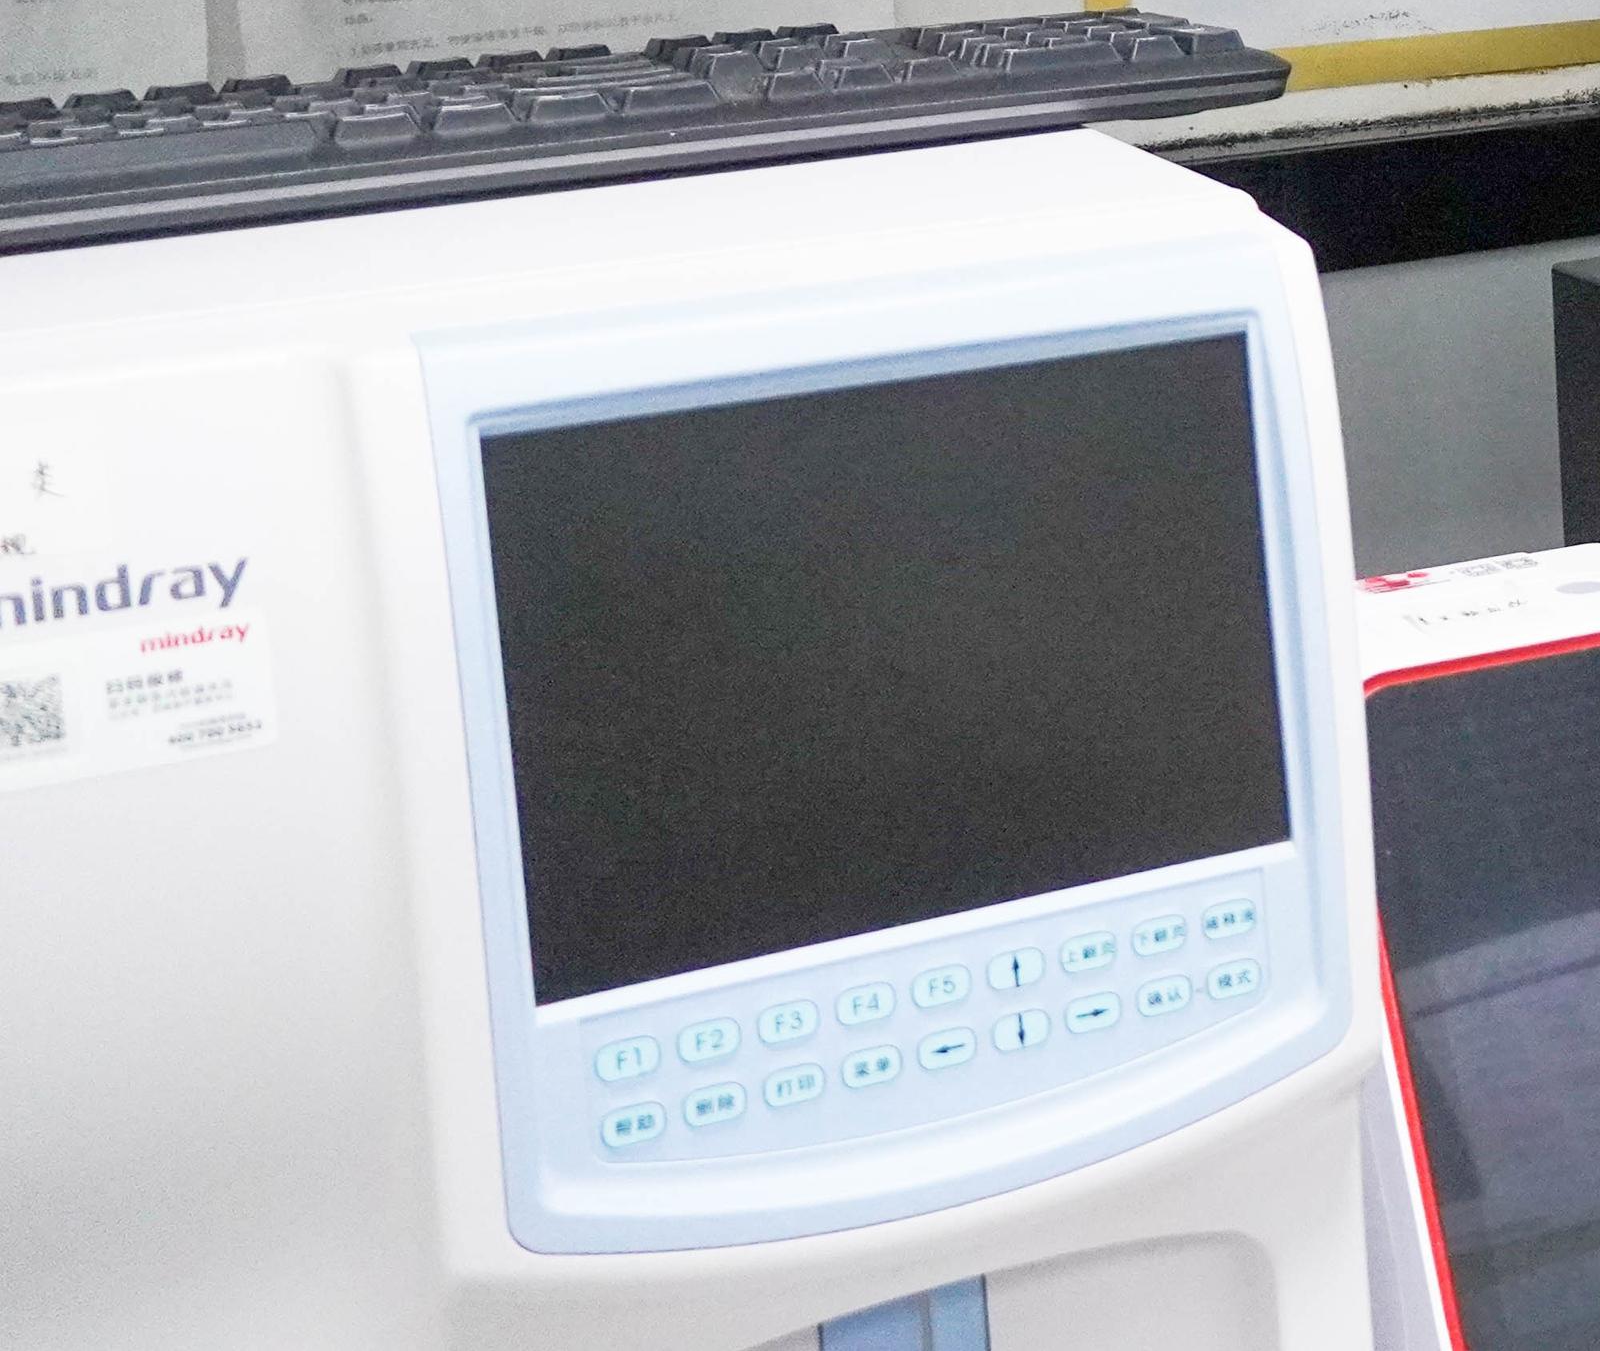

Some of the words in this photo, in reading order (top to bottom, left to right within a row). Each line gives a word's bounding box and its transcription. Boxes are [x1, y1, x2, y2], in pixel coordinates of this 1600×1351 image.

[140, 622, 249, 654] mindray
[928, 974, 957, 998] F5
[853, 992, 880, 1016] F4
[774, 1010, 802, 1034] F3
[695, 1029, 725, 1052] F2
[616, 1047, 642, 1071] F1
